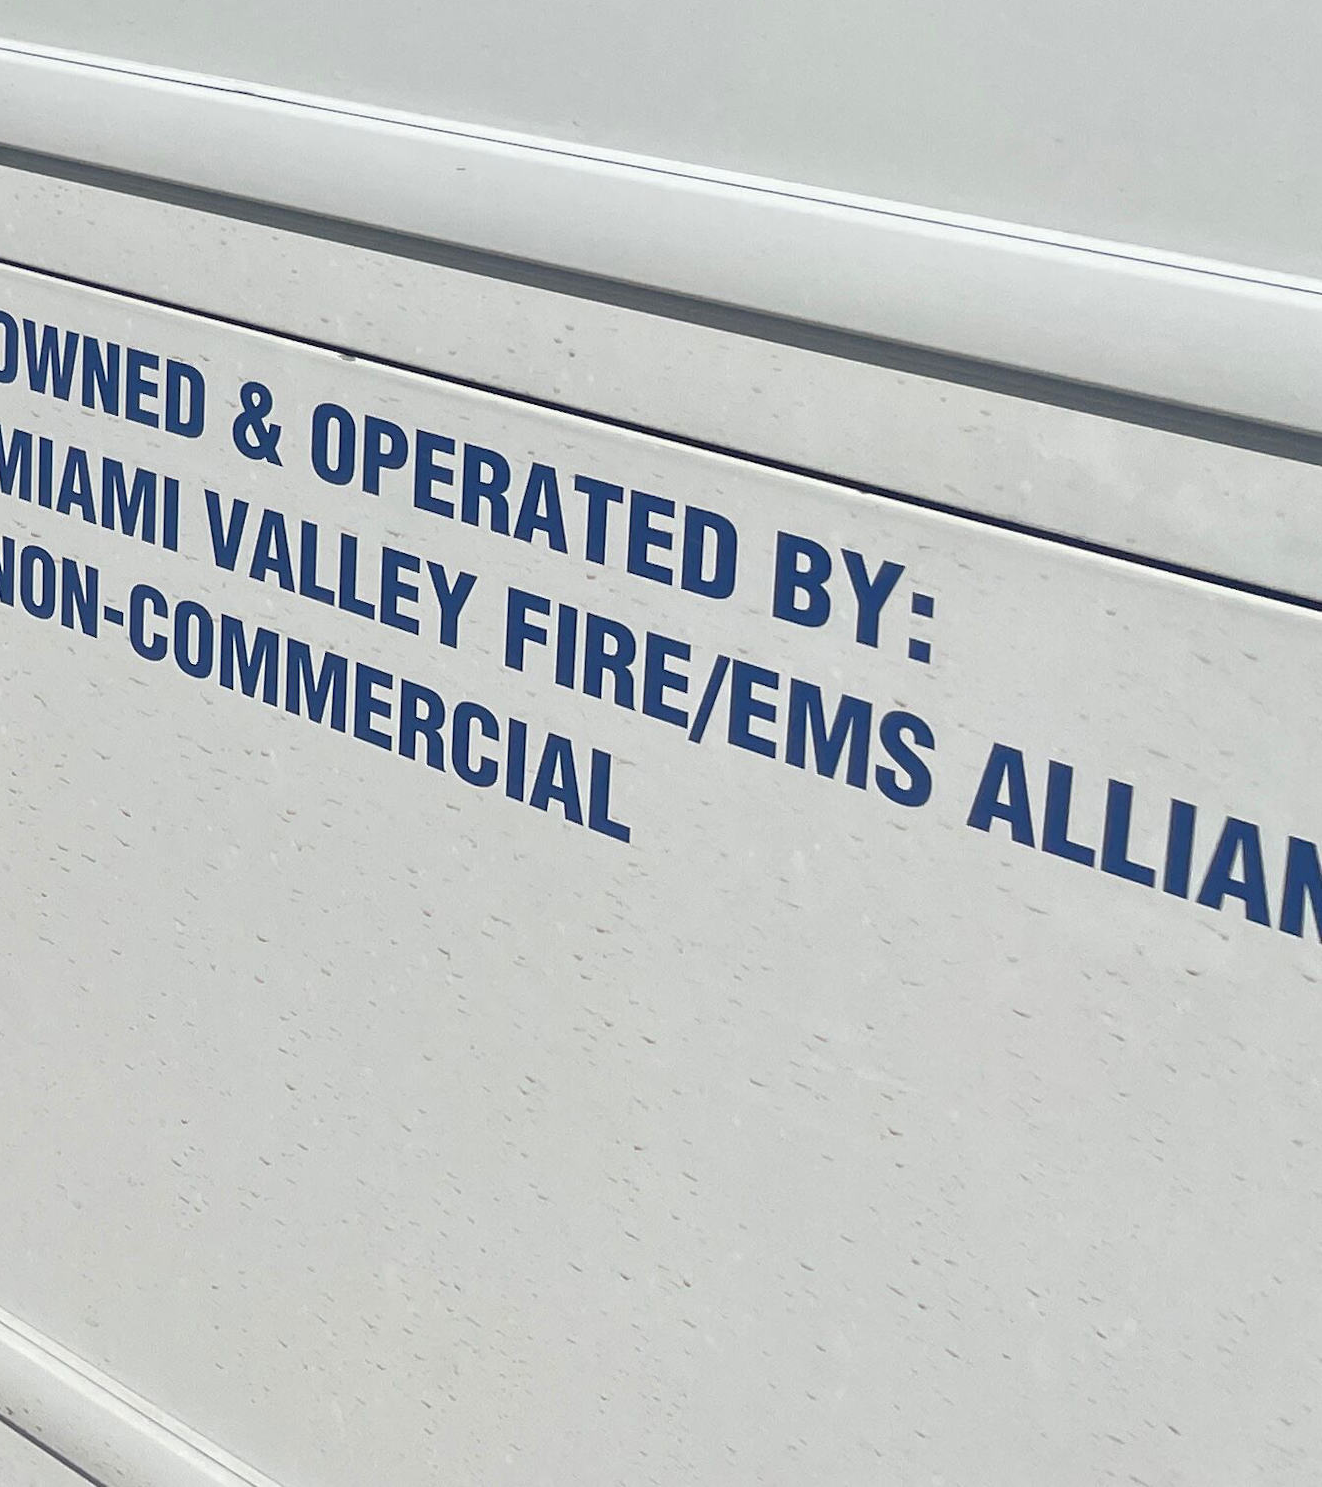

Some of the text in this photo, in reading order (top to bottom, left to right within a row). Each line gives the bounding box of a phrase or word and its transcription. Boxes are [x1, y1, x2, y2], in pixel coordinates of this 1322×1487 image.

[204, 490, 476, 648] VALLEY
[504, 588, 935, 807] FIRE/EMS
[232, 381, 282, 465] &
[311, 403, 738, 600] OPERATED
[773, 534, 934, 662] BY:
